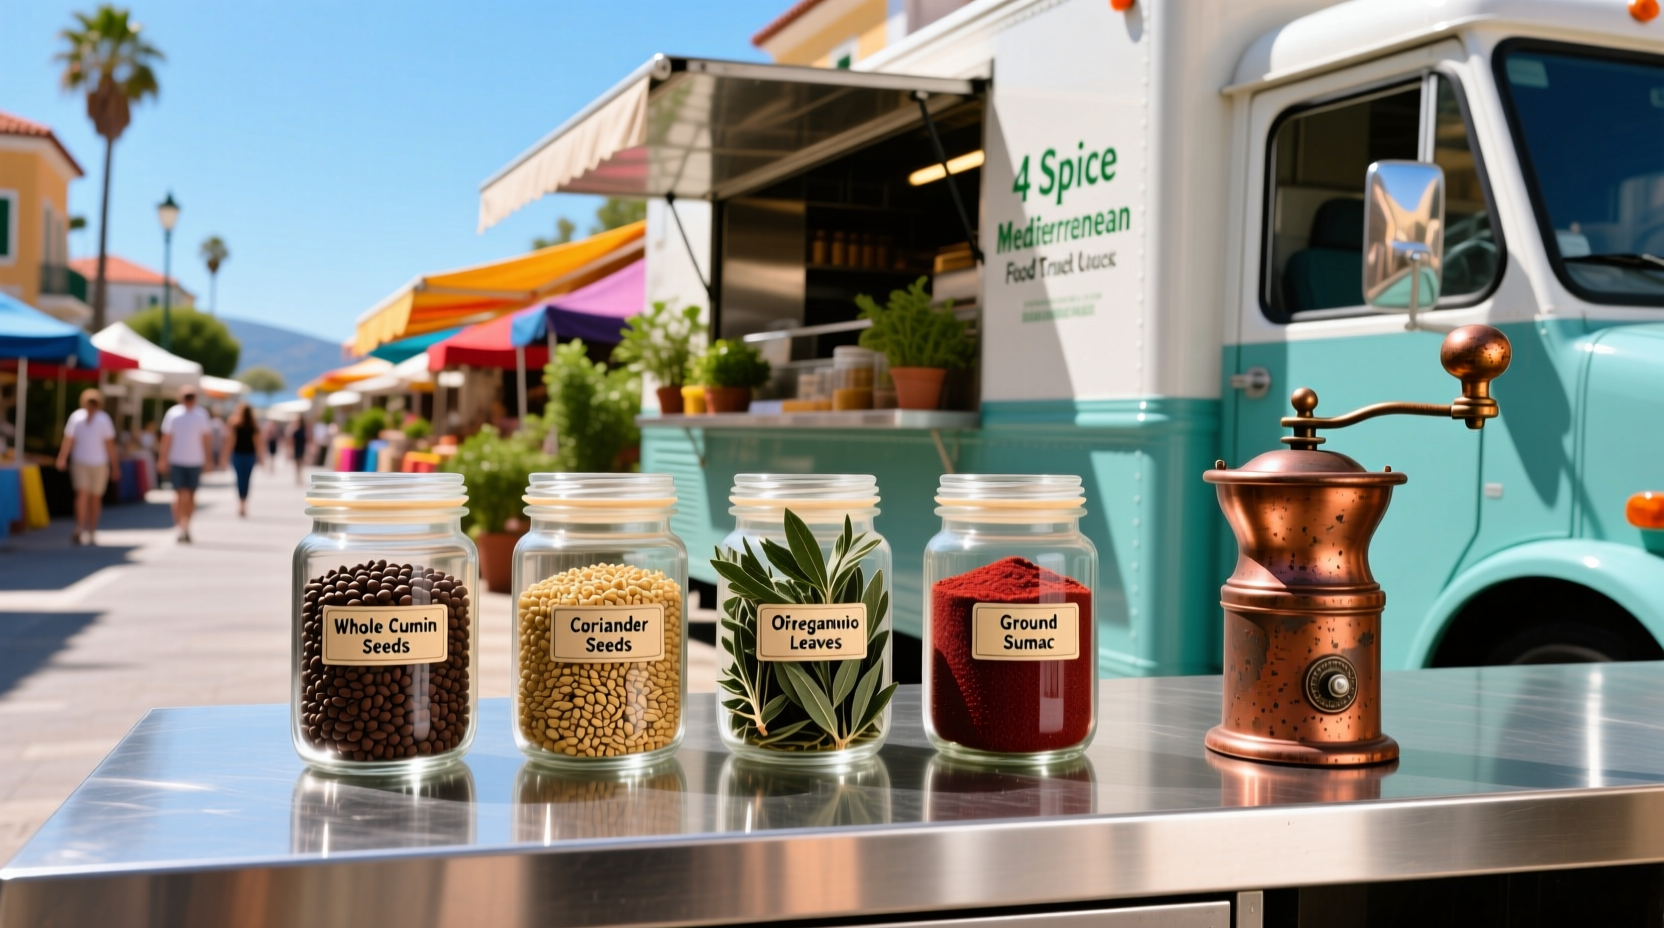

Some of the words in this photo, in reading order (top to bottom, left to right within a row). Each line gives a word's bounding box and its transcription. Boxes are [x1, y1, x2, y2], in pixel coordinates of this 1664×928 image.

[1012, 154, 1031, 202] 4
[1038, 141, 1117, 205] Spice
[334, 617, 383, 635] Whole
[570, 615, 649, 634] Coriander
[999, 613, 1058, 631] Ground
[362, 637, 411, 655] Seeds
[585, 636, 632, 653] Seeds
[790, 635, 843, 650] Leaves
[1003, 633, 1055, 651] Sumac
